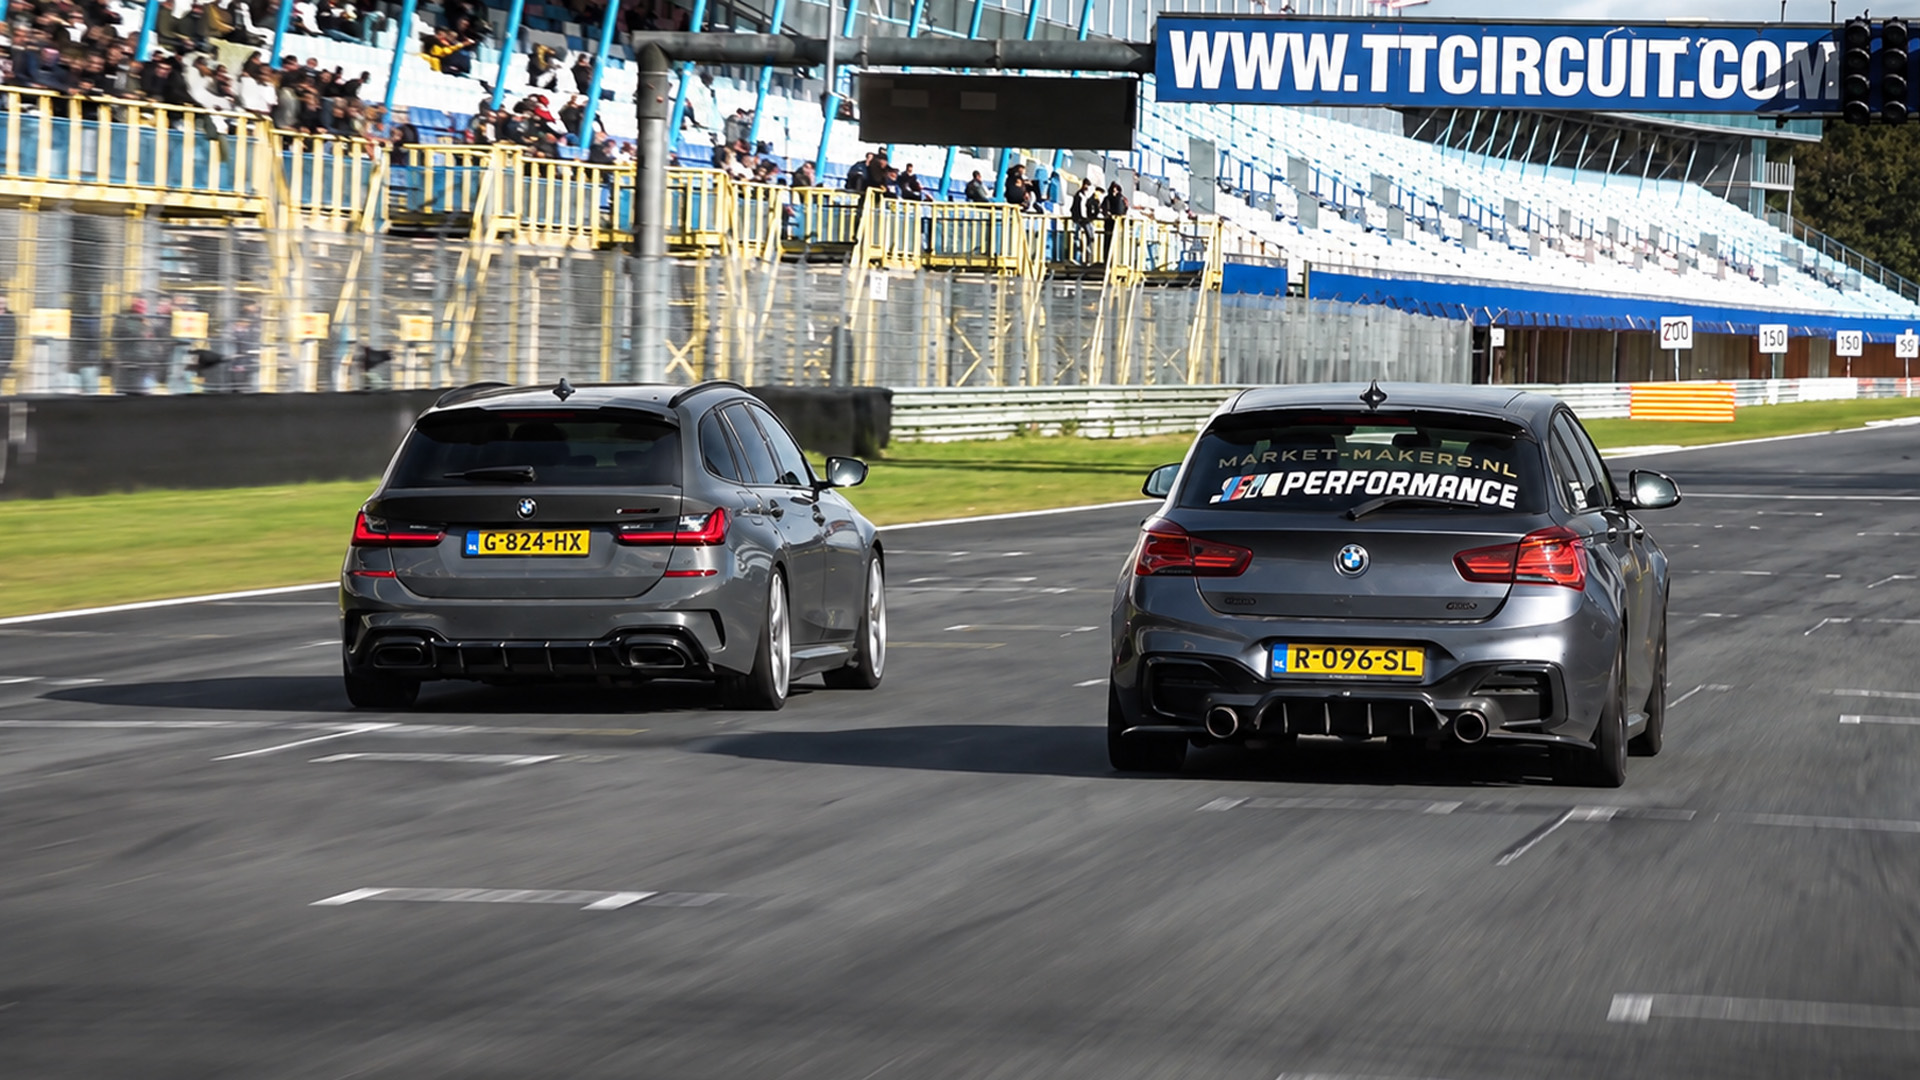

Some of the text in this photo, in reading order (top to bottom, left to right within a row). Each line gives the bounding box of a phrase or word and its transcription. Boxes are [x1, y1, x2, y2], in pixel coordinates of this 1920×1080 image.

[1169, 29, 1840, 101] WWW.TTCIRCUIT.COM
[1663, 320, 1689, 342] 200
[1763, 329, 1784, 347] 150
[1840, 335, 1860, 351] 150
[1218, 449, 1518, 478] MARKET-MAKERS.NL
[1281, 470, 1519, 509] PERFORMANCE
[484, 532, 582, 551] G-824-HX
[1294, 647, 1416, 672] R-096-SL
